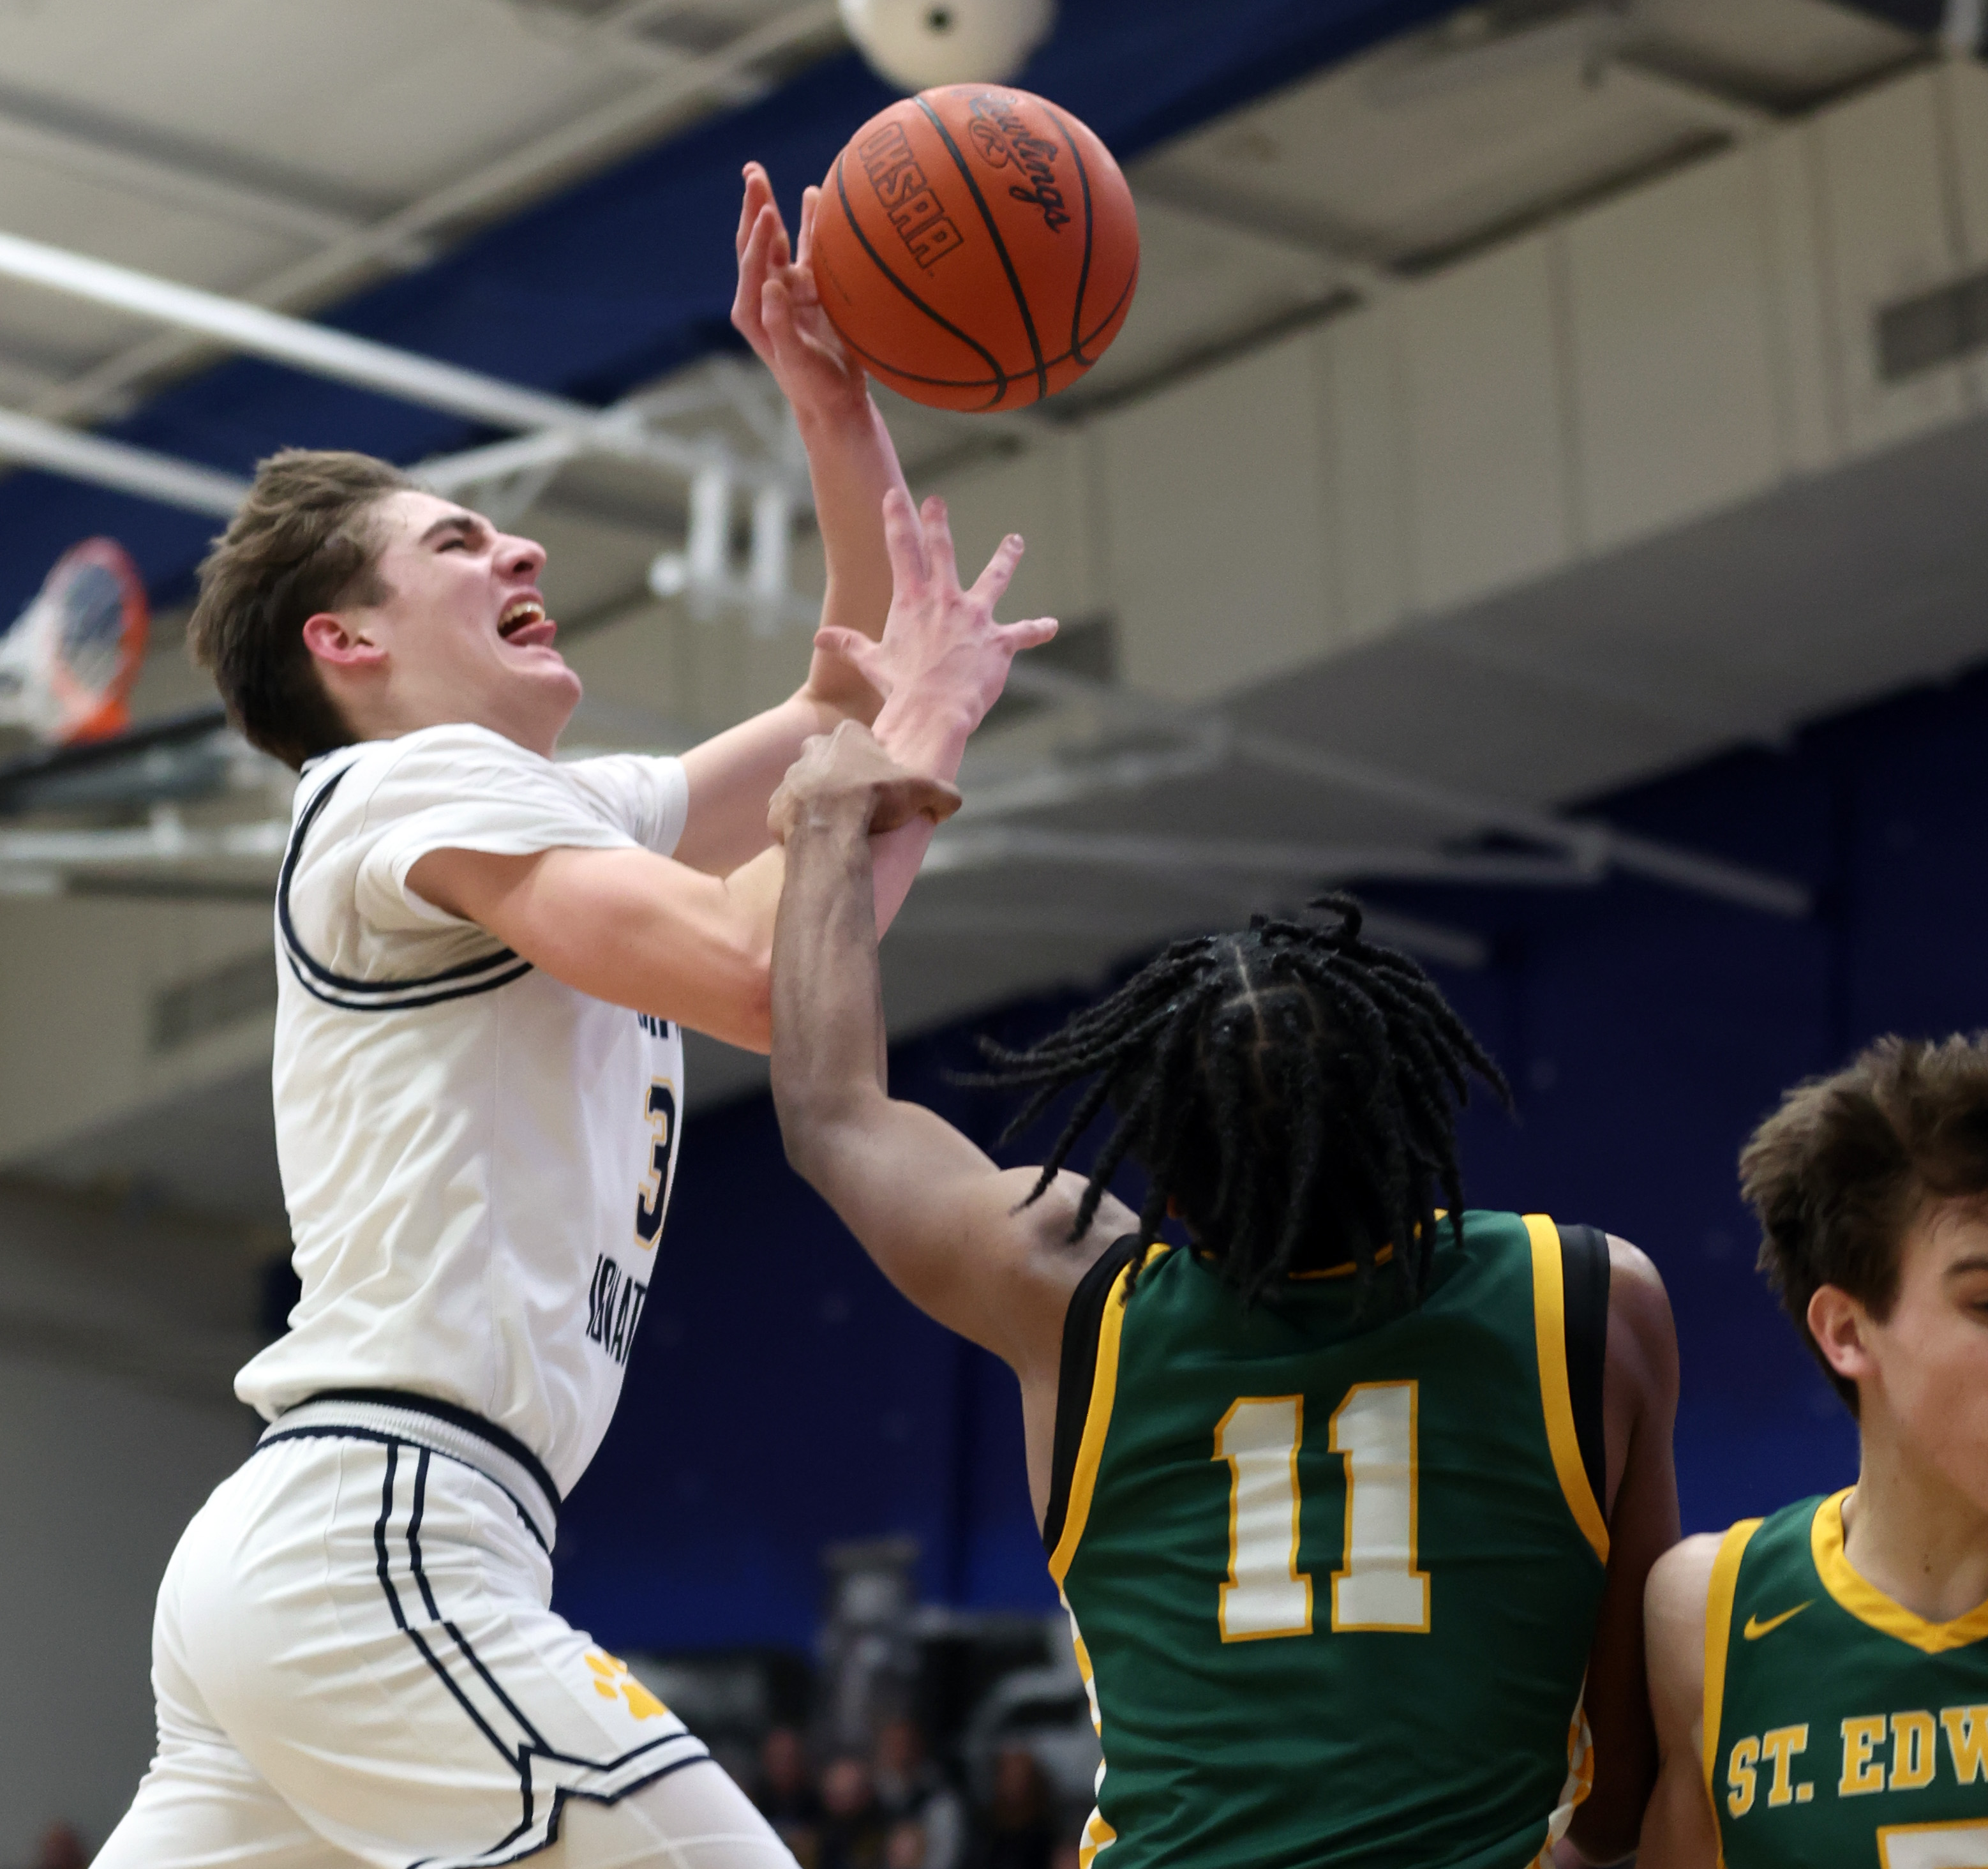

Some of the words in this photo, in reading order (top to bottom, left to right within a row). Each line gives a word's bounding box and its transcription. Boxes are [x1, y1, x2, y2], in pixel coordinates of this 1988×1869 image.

[858, 121, 964, 269] OHSAA
[633, 1076, 675, 1251] 3
[1211, 1379, 1431, 1644] 11
[1727, 1723, 1814, 1819] ST.
